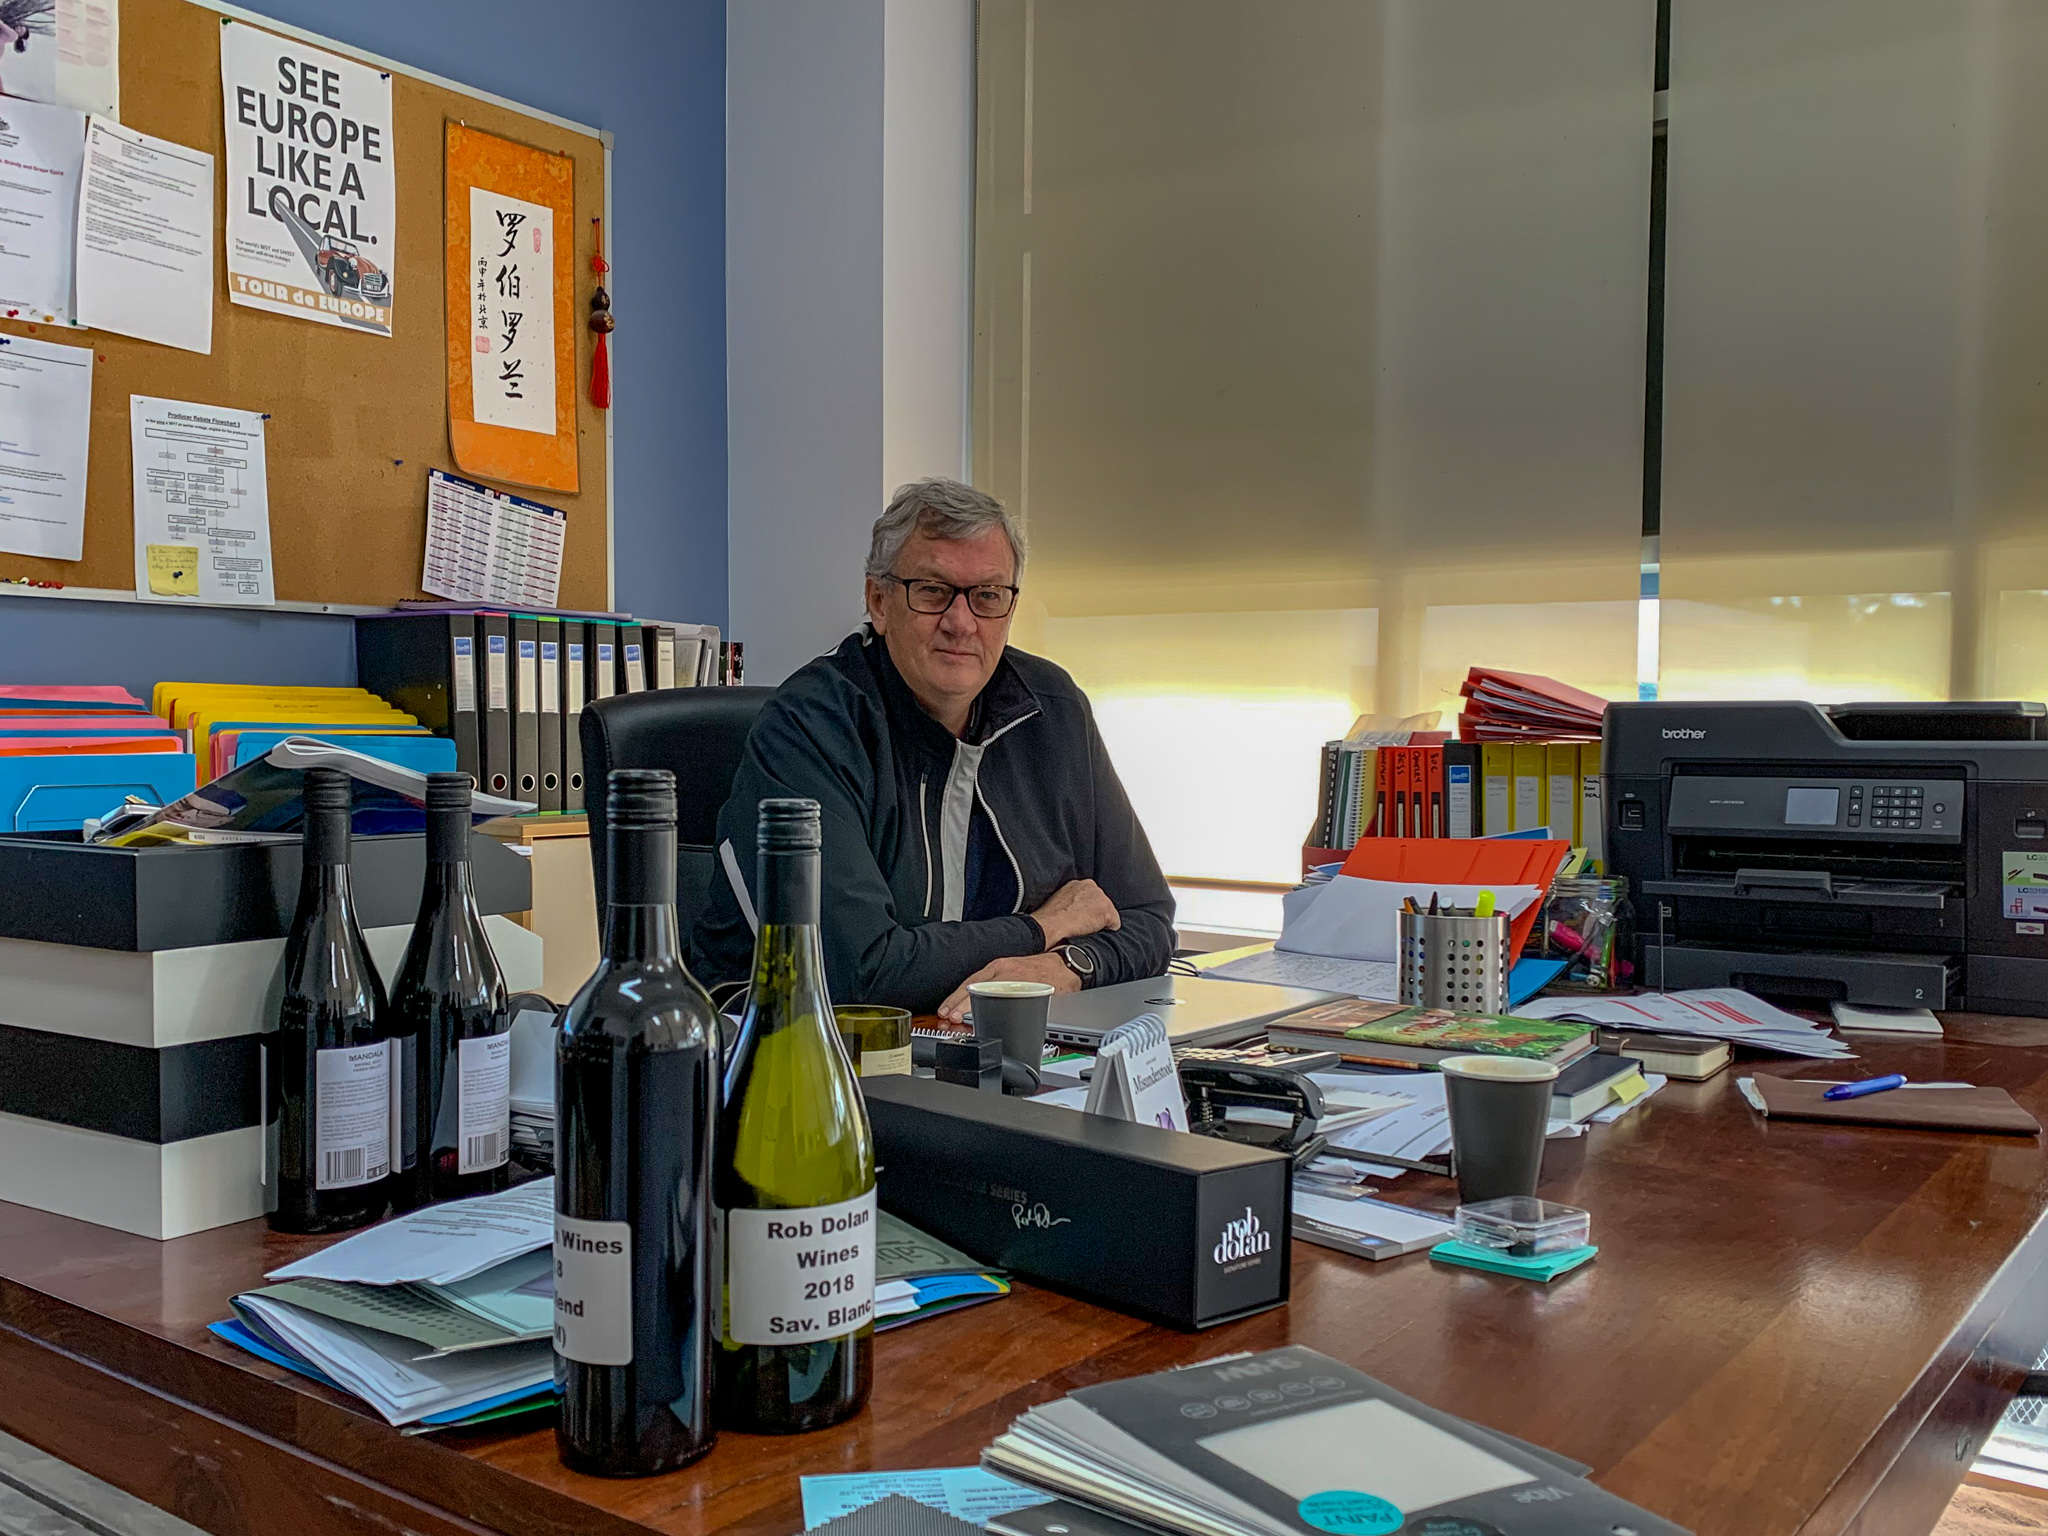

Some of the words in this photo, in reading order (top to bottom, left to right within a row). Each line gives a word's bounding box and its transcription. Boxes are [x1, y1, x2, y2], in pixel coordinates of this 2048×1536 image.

[278, 56, 341, 110] SEE
[236, 85, 381, 163] EUROPE
[257, 135, 331, 192] LIKE
[338, 162, 366, 201] A
[248, 176, 378, 245] LOCAL.
[237, 276, 289, 303] TOUR
[293, 289, 316, 308] de
[318, 295, 385, 323] EUROPE
[168, 411, 192, 421] Producer
[212, 417, 237, 427] Flowchart
[1662, 728, 1707, 739] brother
[1939, 918, 1944, 928] 1
[1915, 988, 1924, 999] 2
[348, 1050, 384, 1062] MANDALA
[990, 1183, 1028, 1205] SERIES
[767, 1221, 813, 1240] Rob
[821, 1209, 869, 1236] Dolan
[1226, 1205, 1260, 1241] rob
[561, 1229, 624, 1255] Wines
[1213, 1227, 1271, 1265] dolan
[797, 1244, 859, 1270] Wines
[804, 1273, 855, 1300] 2018
[769, 1316, 820, 1334] Sav.
[827, 1299, 872, 1328] Blanc
[1323, 1513, 1394, 1526] PAINT
